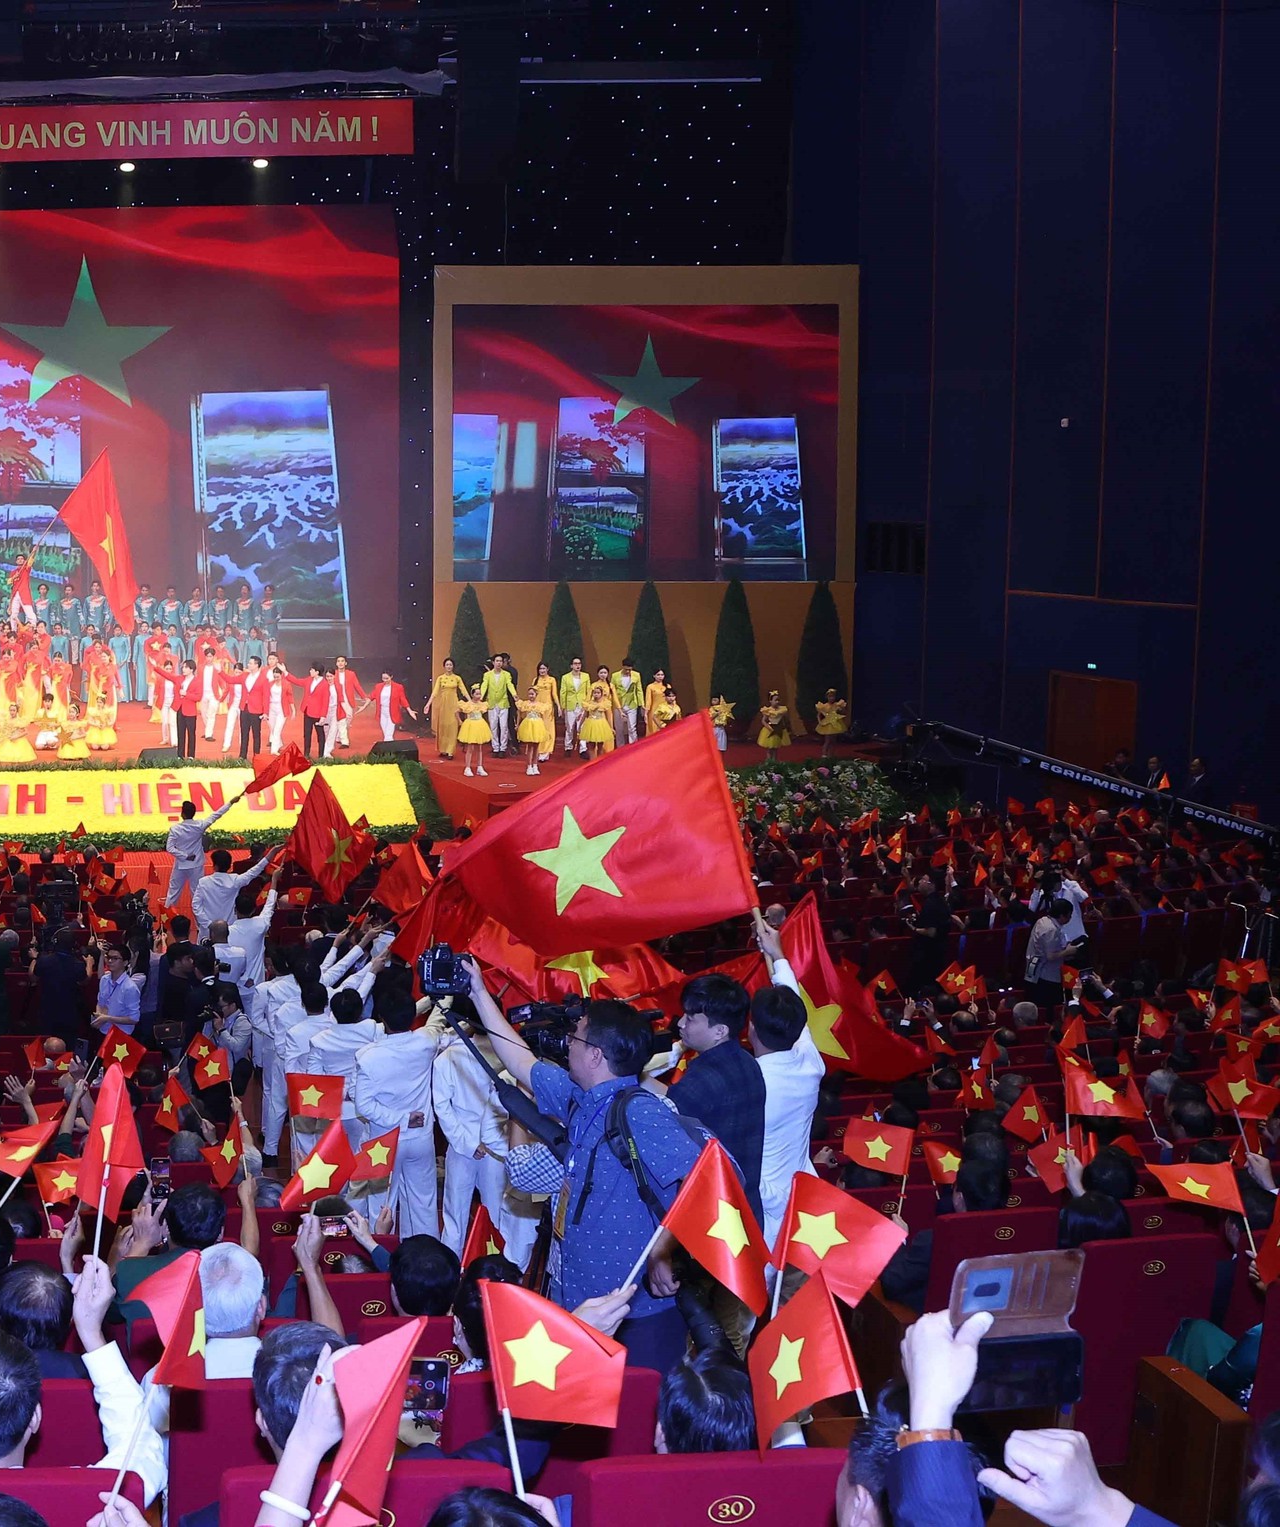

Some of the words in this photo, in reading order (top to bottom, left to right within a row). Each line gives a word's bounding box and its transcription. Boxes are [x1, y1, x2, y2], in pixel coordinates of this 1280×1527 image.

[96, 119, 171, 147] VINH
[184, 112, 278, 145] MUÔN
[290, 111, 361, 143] NĂM
[370, 115, 379, 142] !
[102, 773, 224, 821] HIỆN
[1039, 761, 1145, 799] EGRIPMENT
[366, 1304, 381, 1313] 27
[718, 1501, 744, 1518] 30
